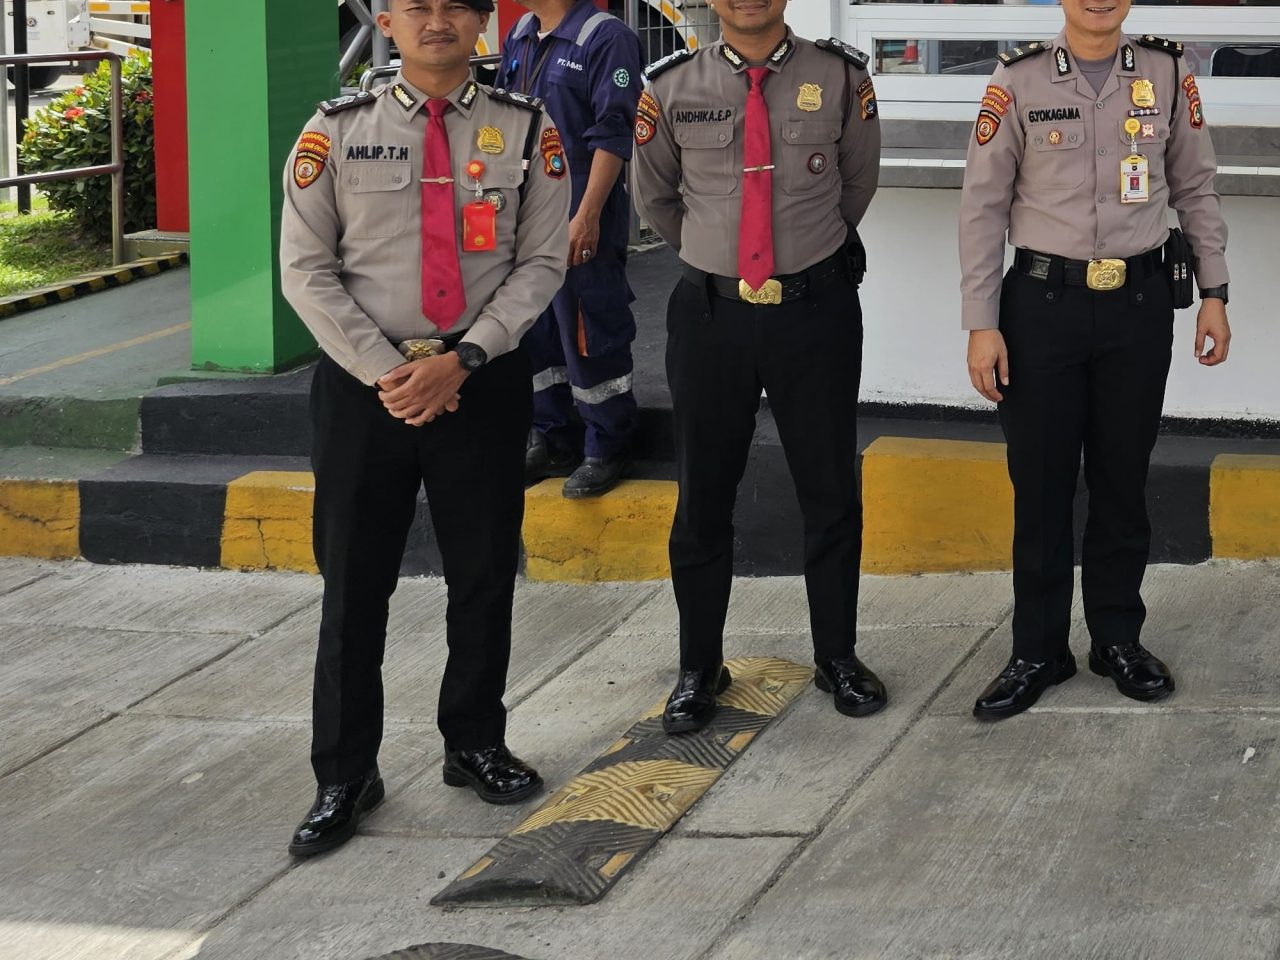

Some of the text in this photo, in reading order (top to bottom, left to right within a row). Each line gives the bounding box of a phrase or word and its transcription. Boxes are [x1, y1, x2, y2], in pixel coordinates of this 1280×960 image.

[566, 60, 583, 71] MMS
[675, 109, 732, 124] ANDHIKA.E.P
[346, 145, 409, 161] AHLIP.T.H
